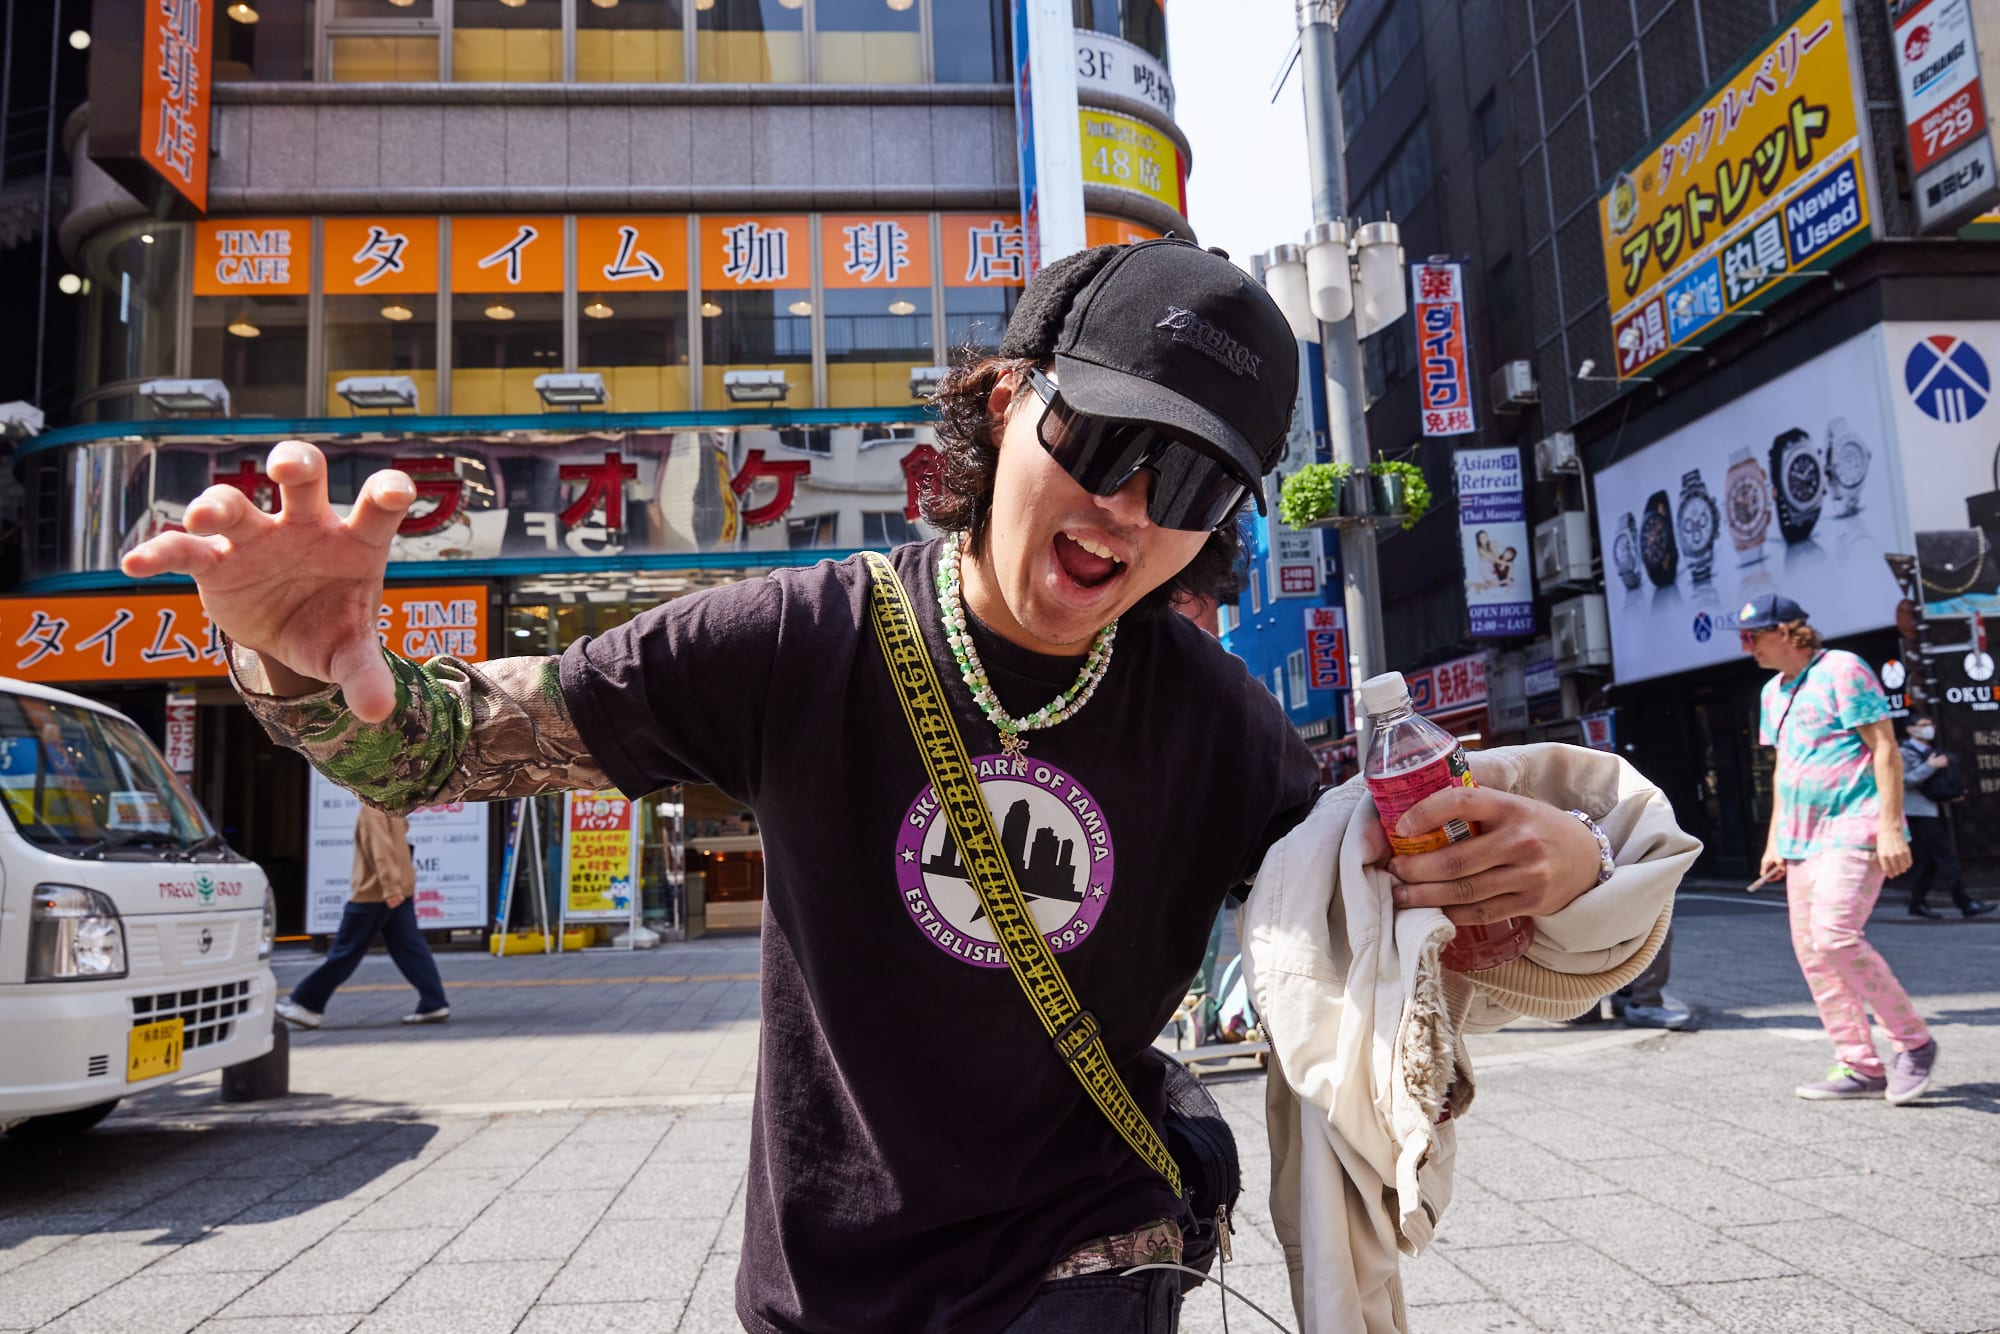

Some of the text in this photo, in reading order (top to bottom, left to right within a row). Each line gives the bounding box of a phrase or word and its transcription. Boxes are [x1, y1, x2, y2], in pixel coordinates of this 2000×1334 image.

[1079, 47, 1114, 80] 3F
[1912, 40, 1966, 92] EXCHANGE
[1656, 19, 1833, 197] タックルベリー
[1922, 92, 1970, 135] BRAND
[1923, 107, 1974, 157] 729
[1621, 96, 1831, 296] アウトレット
[216, 229, 291, 256] TIME
[1796, 198, 1858, 256] Used
[215, 257, 291, 284] CAFE
[353, 221, 1024, 286] タイム珈琲店
[1723, 216, 1788, 303] 釣具
[1419, 267, 1454, 300] 薬
[1424, 304, 1460, 408] ダイコク
[1425, 409, 1472, 434] 免税
[1458, 454, 1502, 472] Asian
[212, 443, 945, 538] ラオケ
[1460, 474, 1518, 490] Retreat
[1464, 508, 1522, 521] Thai Massage
[402, 600, 477, 628] TIME
[1469, 604, 1531, 618] OPEN HOUR
[1471, 620, 1497, 633] 12:00
[1507, 618, 1533, 630] LAST
[402, 629, 477, 657] CAFE
[1315, 632, 1339, 686] ダイコク
[1437, 662, 1470, 704] 免税
[169, 724, 182, 769] ロッカー
[579, 815, 619, 829] パック
[1034, 767, 1065, 790] OF
[1065, 786, 1109, 862] TAMPA
[414, 857, 440, 873] ME
[158, 881, 195, 898] PRECO
[905, 887, 1010, 964] ESTABLISH
